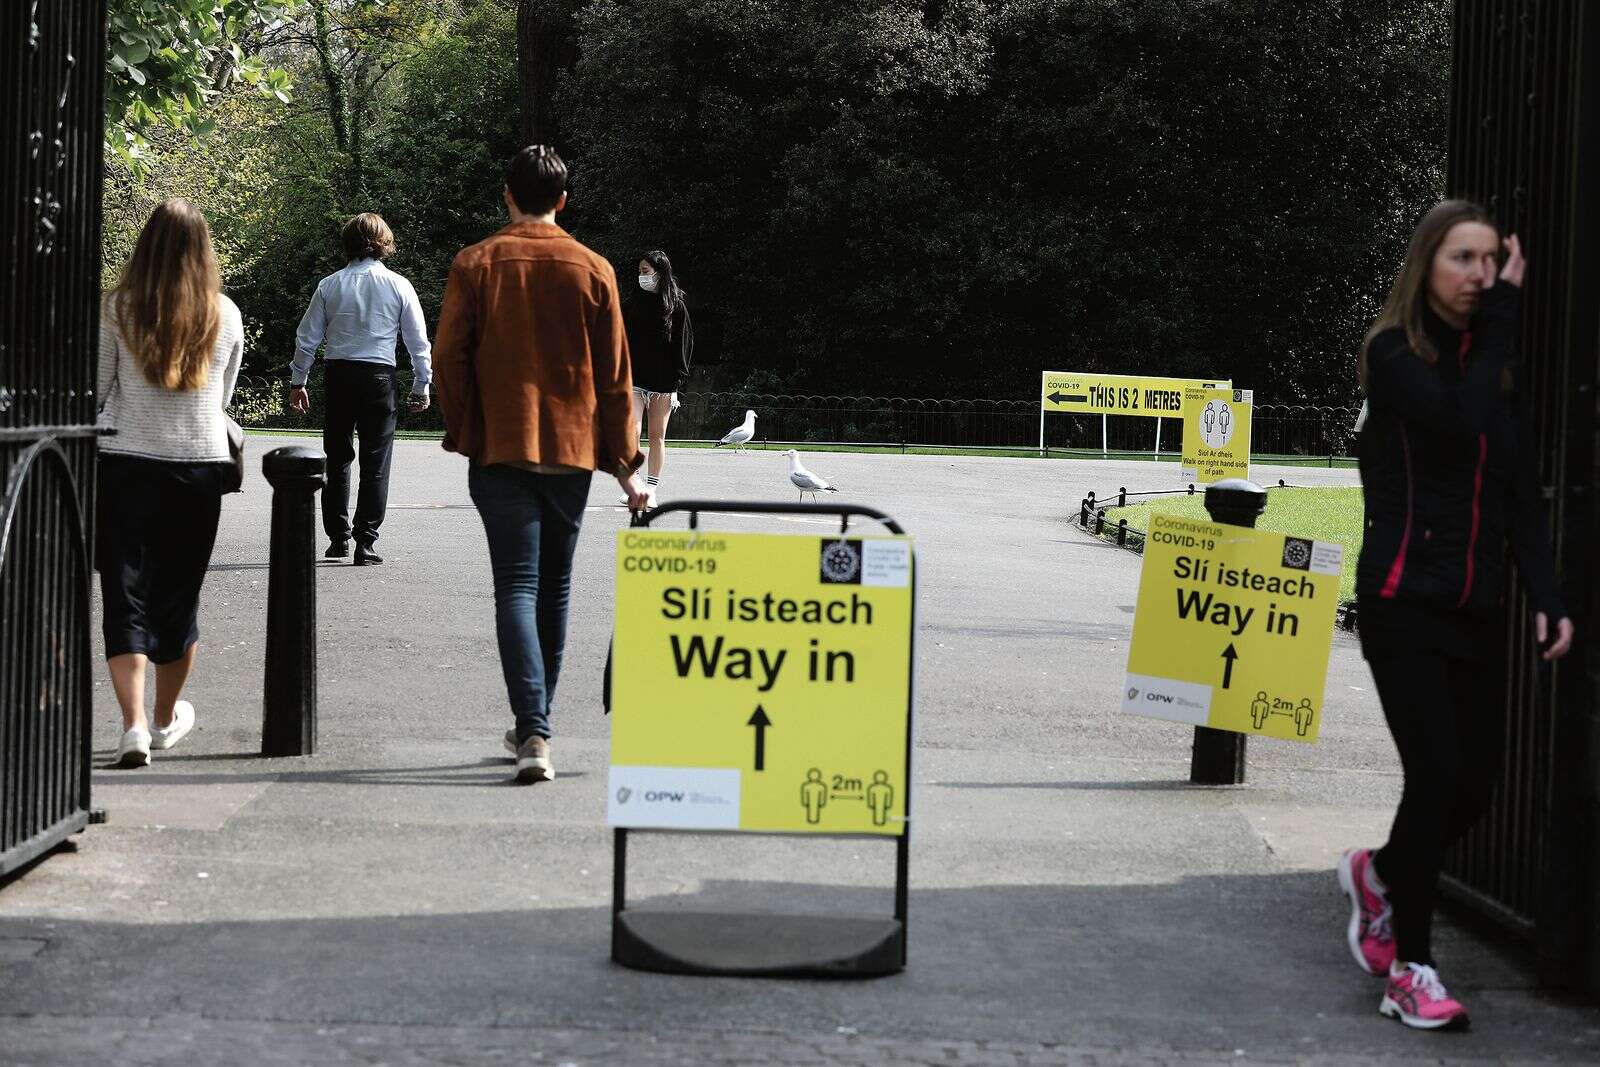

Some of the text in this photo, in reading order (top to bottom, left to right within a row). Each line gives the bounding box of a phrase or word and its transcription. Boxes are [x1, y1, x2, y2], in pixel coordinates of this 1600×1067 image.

[1089, 386, 1181, 411] THIS IS 2 METRES
[1154, 515, 1223, 537] Coronavirus
[624, 533, 726, 551] Coronavirus
[1152, 531, 1215, 551] COVID-19
[624, 556, 717, 574] COVID-19
[1174, 556, 1315, 599] Slí isteach
[662, 587, 873, 624] Slí isteach
[1176, 588, 1299, 636] Way in
[670, 635, 855, 692] Way in
[1273, 697, 1293, 711] 2m
[832, 775, 863, 791] 2m
[645, 791, 685, 802] OPW
